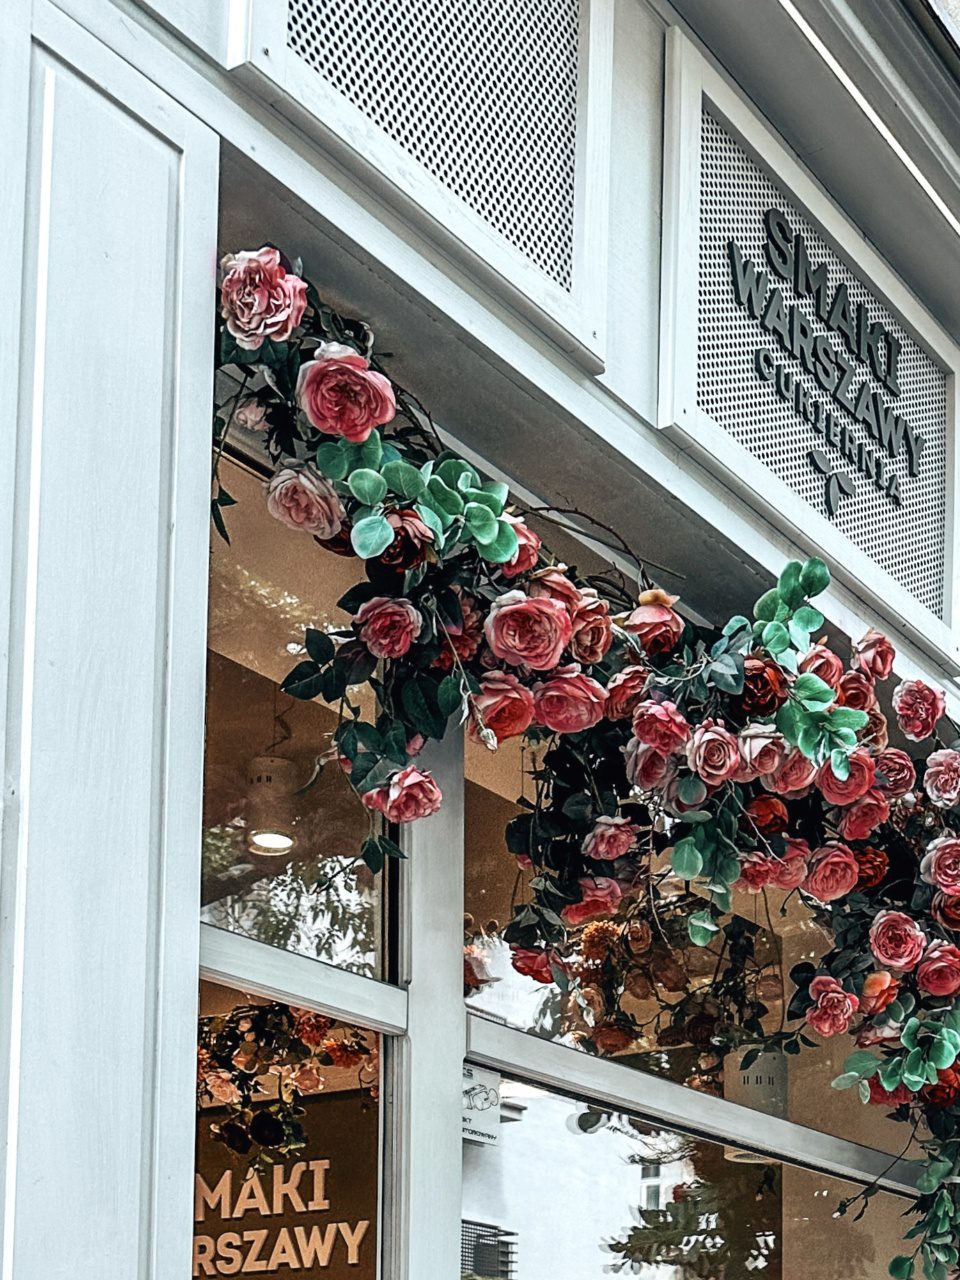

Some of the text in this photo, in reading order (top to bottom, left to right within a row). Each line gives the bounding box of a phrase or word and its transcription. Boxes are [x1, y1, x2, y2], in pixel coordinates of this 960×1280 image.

[727, 240, 926, 478] WARSZAWY
[763, 207, 902, 397] SMAKI
[754, 347, 903, 507] CUKIERNIA
[193, 1220, 370, 1277] RSZAWY
[195, 1158, 331, 1221] MAKI
